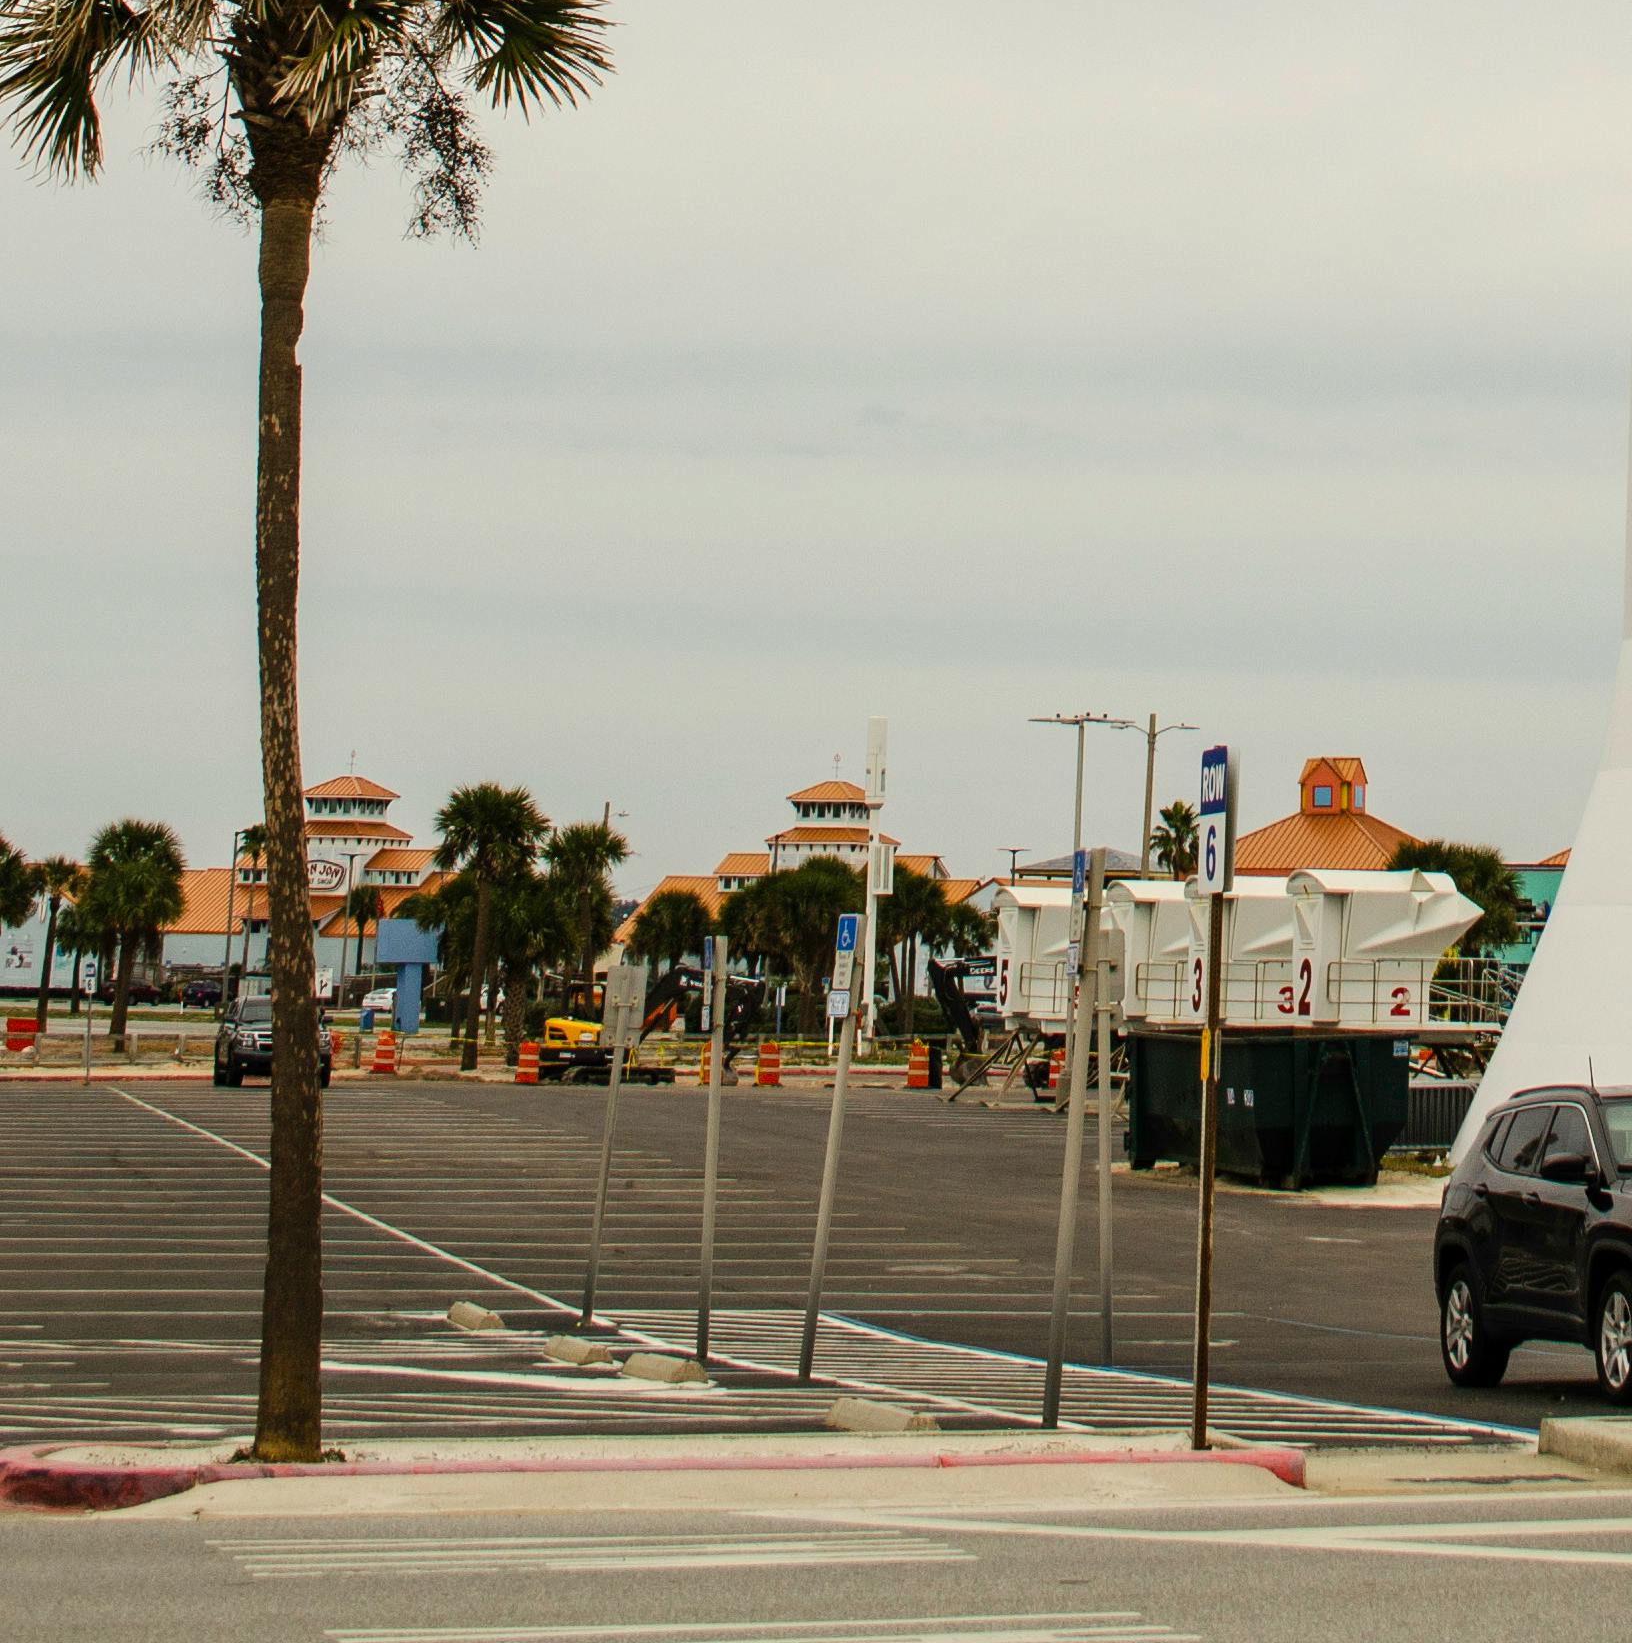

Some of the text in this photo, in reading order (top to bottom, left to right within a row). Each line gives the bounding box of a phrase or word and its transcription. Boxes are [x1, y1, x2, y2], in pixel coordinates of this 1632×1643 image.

[1202, 763, 1226, 802] ROW
[319, 865, 341, 878] JON
[1205, 825, 1217, 882] 6
[1000, 959, 1009, 1006] 5
[1192, 957, 1203, 1013] 3
[1277, 986, 1295, 1013] 3
[1298, 958, 1312, 1015] 2
[1390, 987, 1411, 1016] 2
